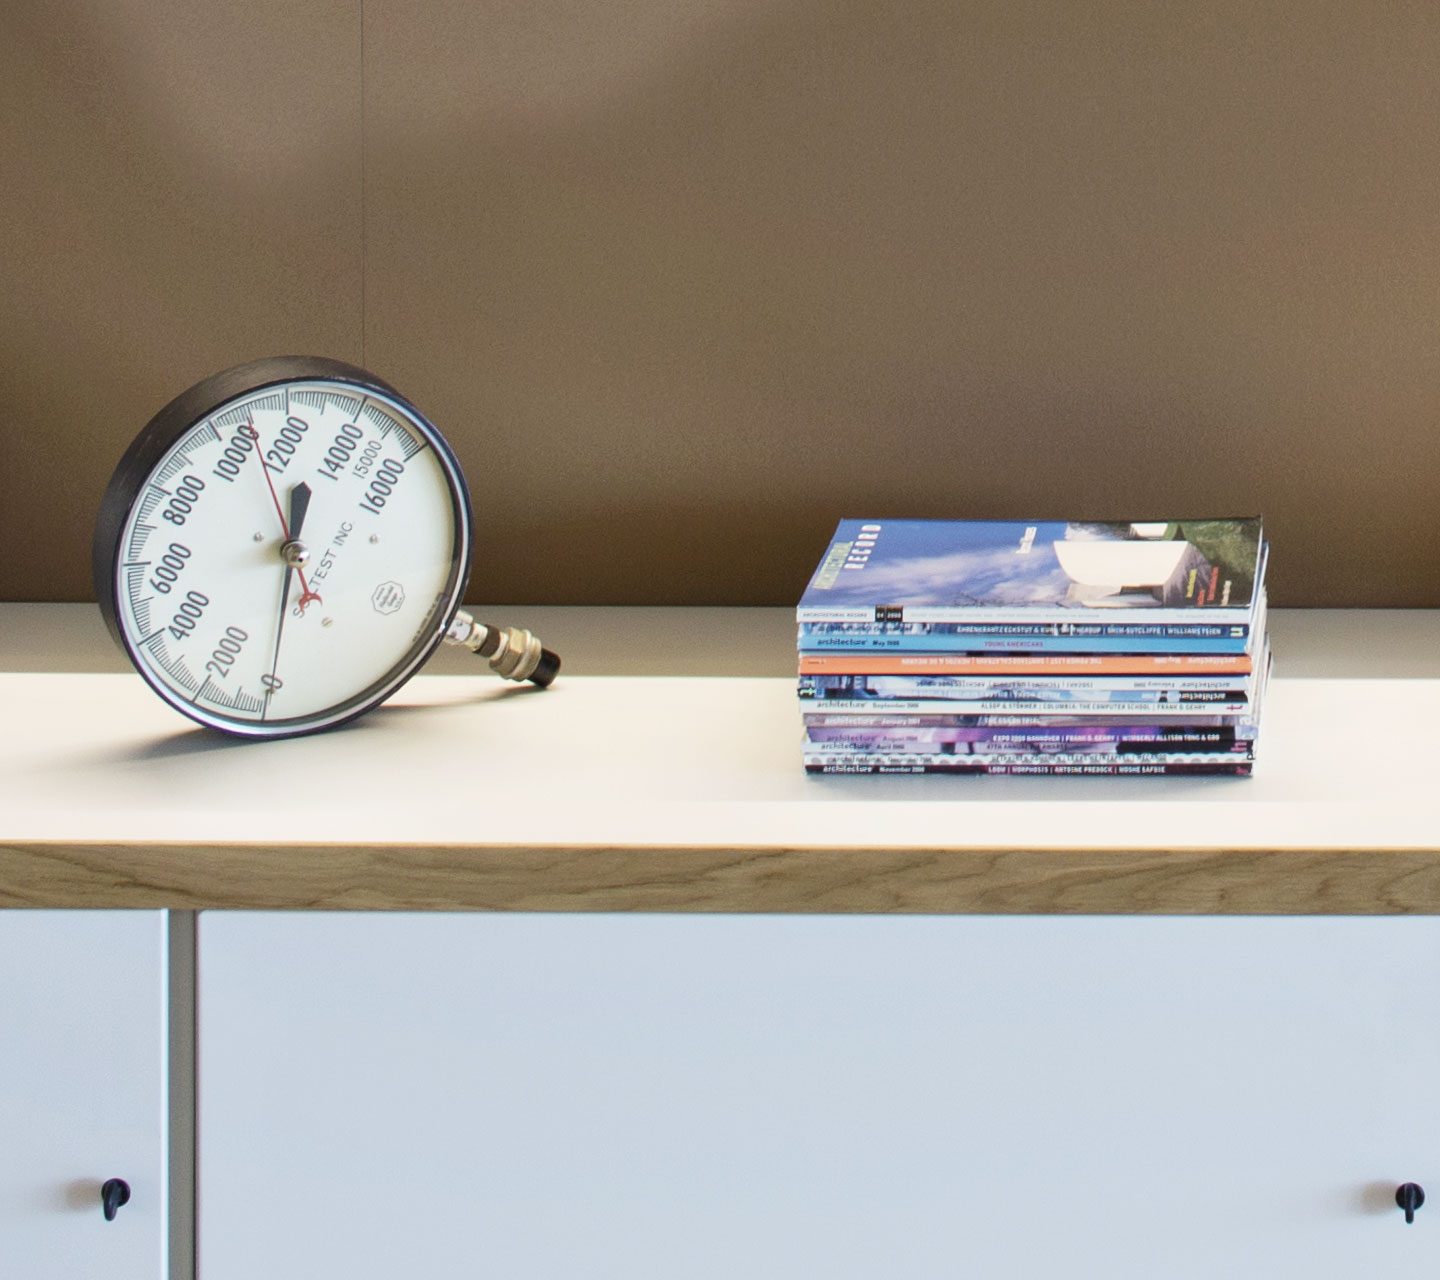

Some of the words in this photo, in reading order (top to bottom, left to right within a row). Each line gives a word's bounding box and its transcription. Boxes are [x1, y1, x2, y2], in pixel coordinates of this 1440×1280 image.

[213, 424, 259, 483] 10000
[266, 416, 310, 474] 12000
[318, 423, 365, 481] 14000
[352, 439, 383, 479] 15000
[163, 474, 207, 527] 8000
[359, 458, 405, 516] 16000
[149, 542, 193, 595] 6000
[843, 524, 882, 570] RECORD
[167, 590, 210, 642] 4000
[205, 626, 249, 678] 2000
[817, 637, 867, 646] architecture
[817, 700, 867, 708] architecture
[1180, 692, 1226, 700] architectur
[824, 716, 875, 725] architecture
[827, 734, 876, 743] architecture
[993, 734, 1010, 742] EXPO
[821, 742, 871, 751] architecture
[823, 765, 873, 773] architecture
